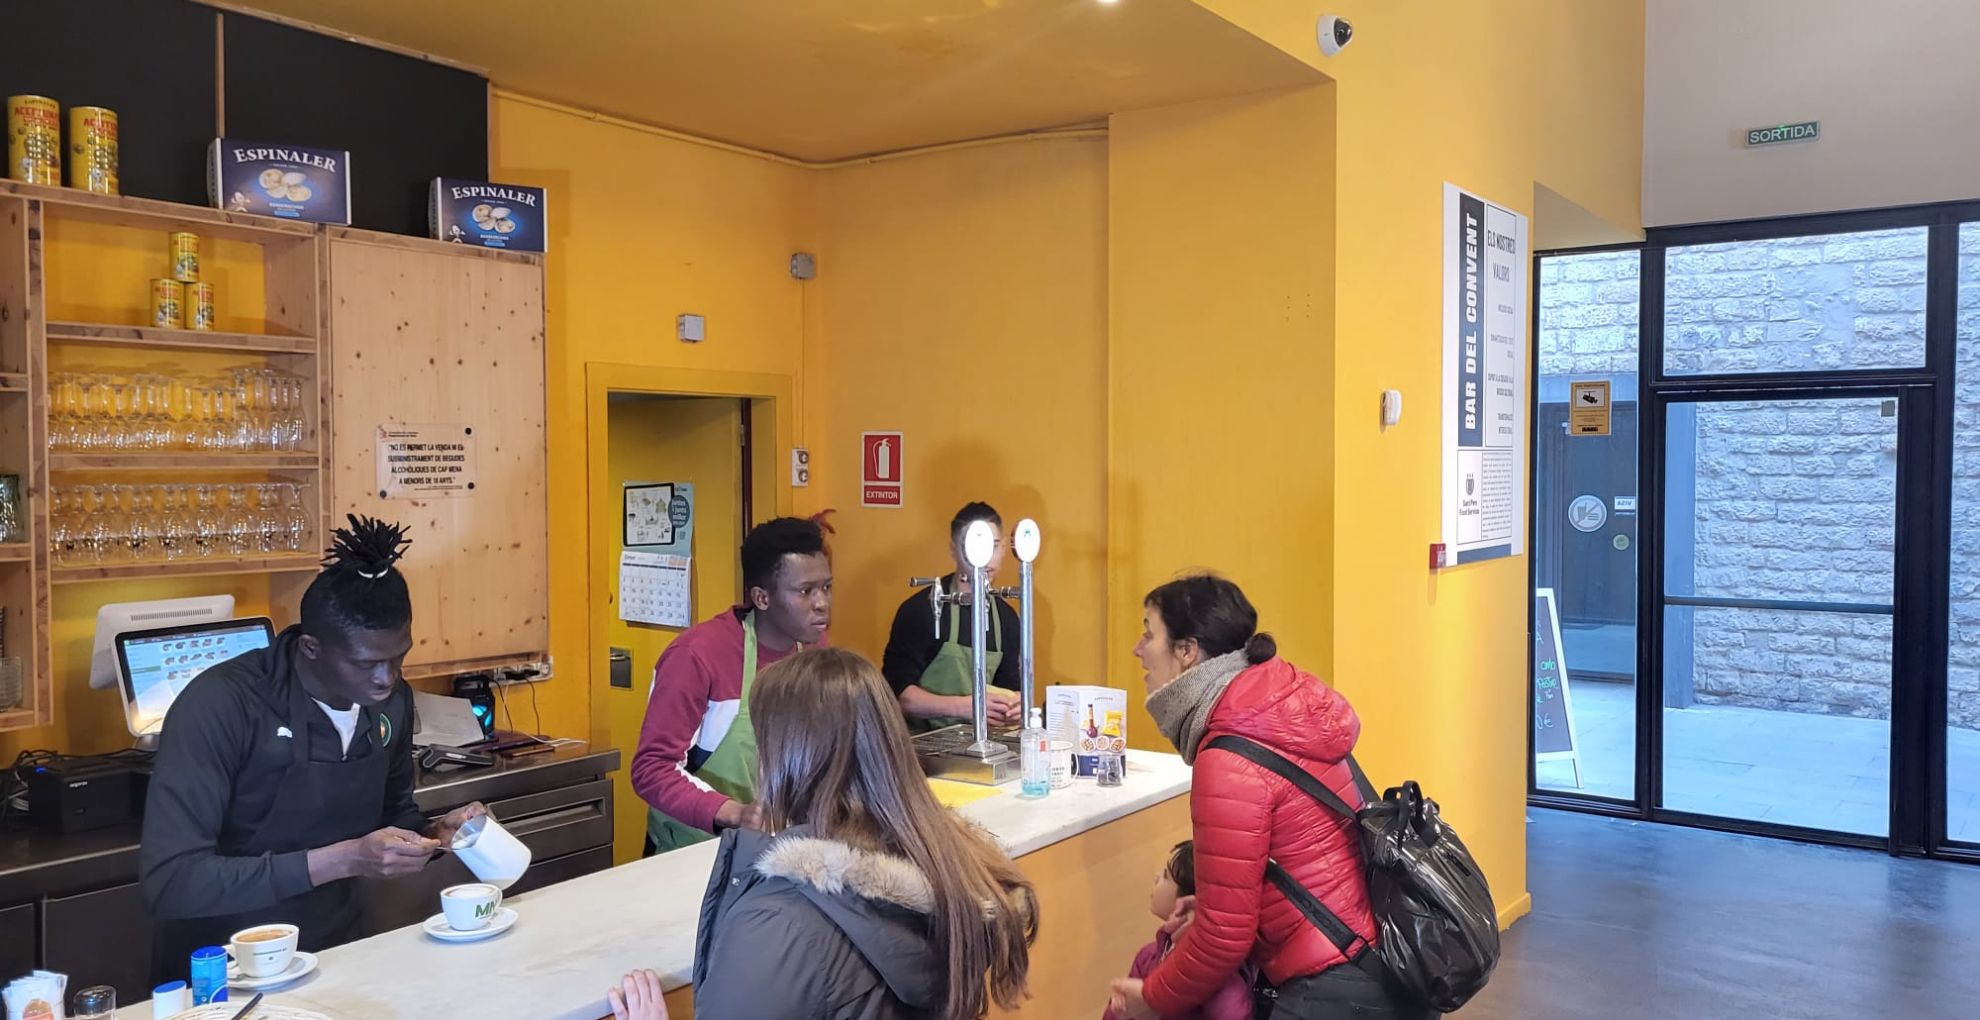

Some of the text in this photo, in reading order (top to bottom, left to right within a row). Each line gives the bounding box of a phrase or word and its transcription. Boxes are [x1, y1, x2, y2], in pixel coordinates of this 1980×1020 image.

[1750, 124, 1816, 143] SORTIDA
[233, 148, 336, 173] ESPINALER
[451, 186, 536, 207] ESPINALER
[1488, 229, 1496, 249] ELS
[1465, 212, 1478, 430] BAR DEL CONVENT
[866, 491, 898, 499] EXTINTOR
